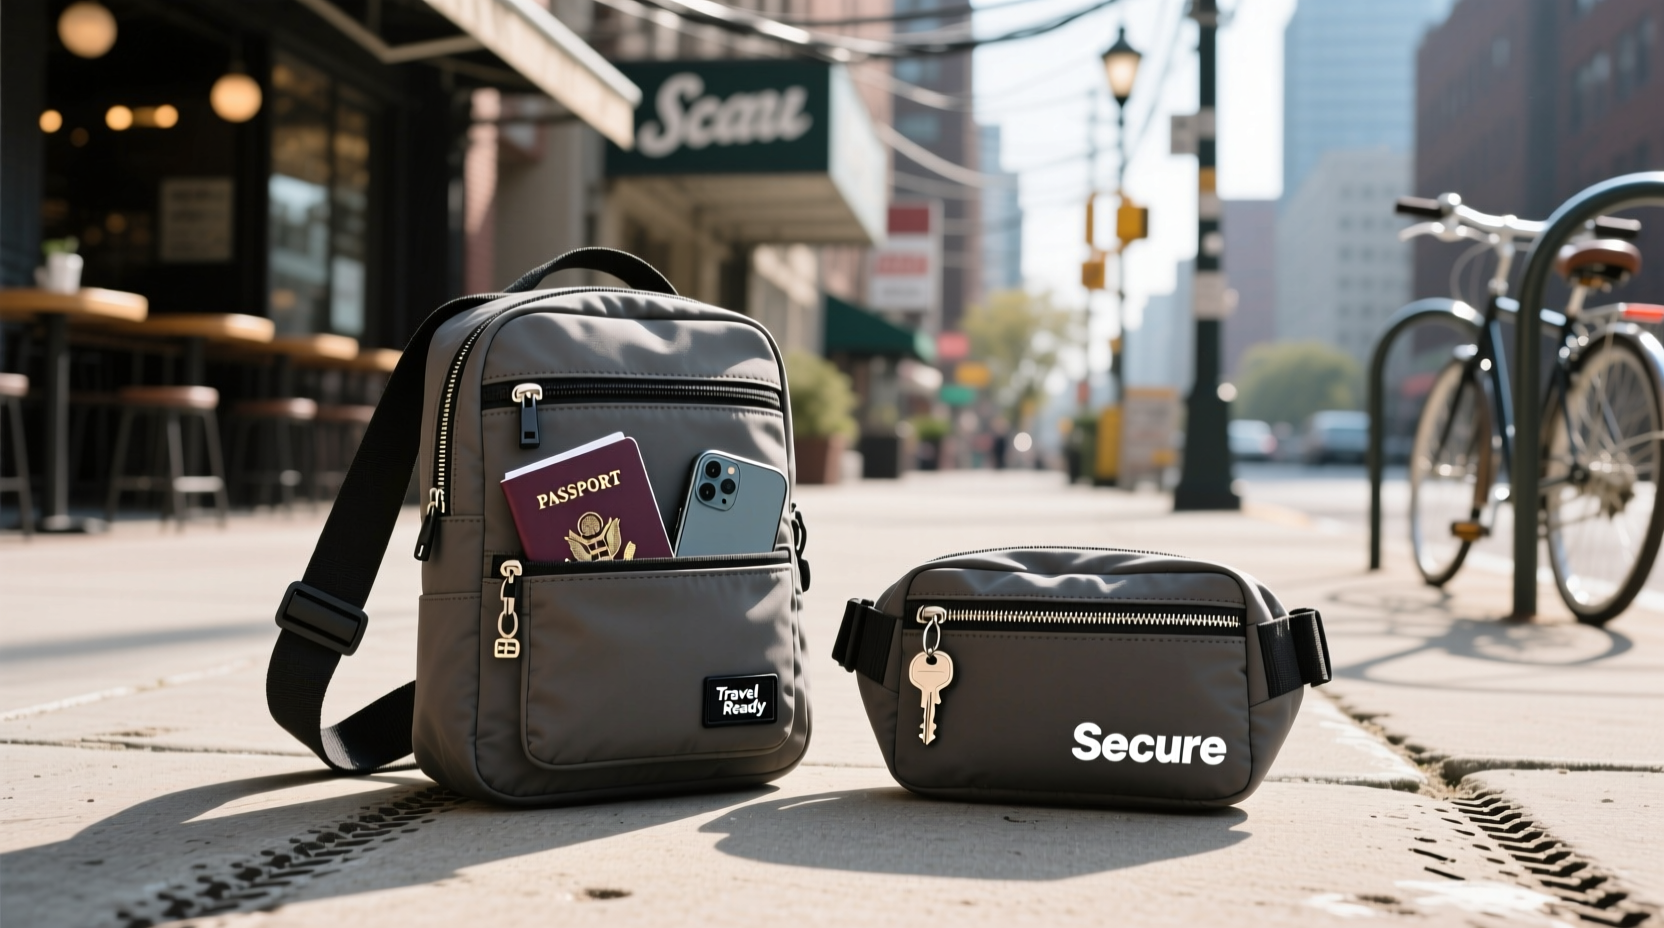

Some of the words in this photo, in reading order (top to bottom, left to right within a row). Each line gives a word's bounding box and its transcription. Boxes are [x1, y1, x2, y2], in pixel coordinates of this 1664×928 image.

[536, 469, 621, 510] PASSPORT
[716, 683, 759, 701] Travel
[722, 698, 767, 718] Ready
[1071, 721, 1227, 766] Secure
